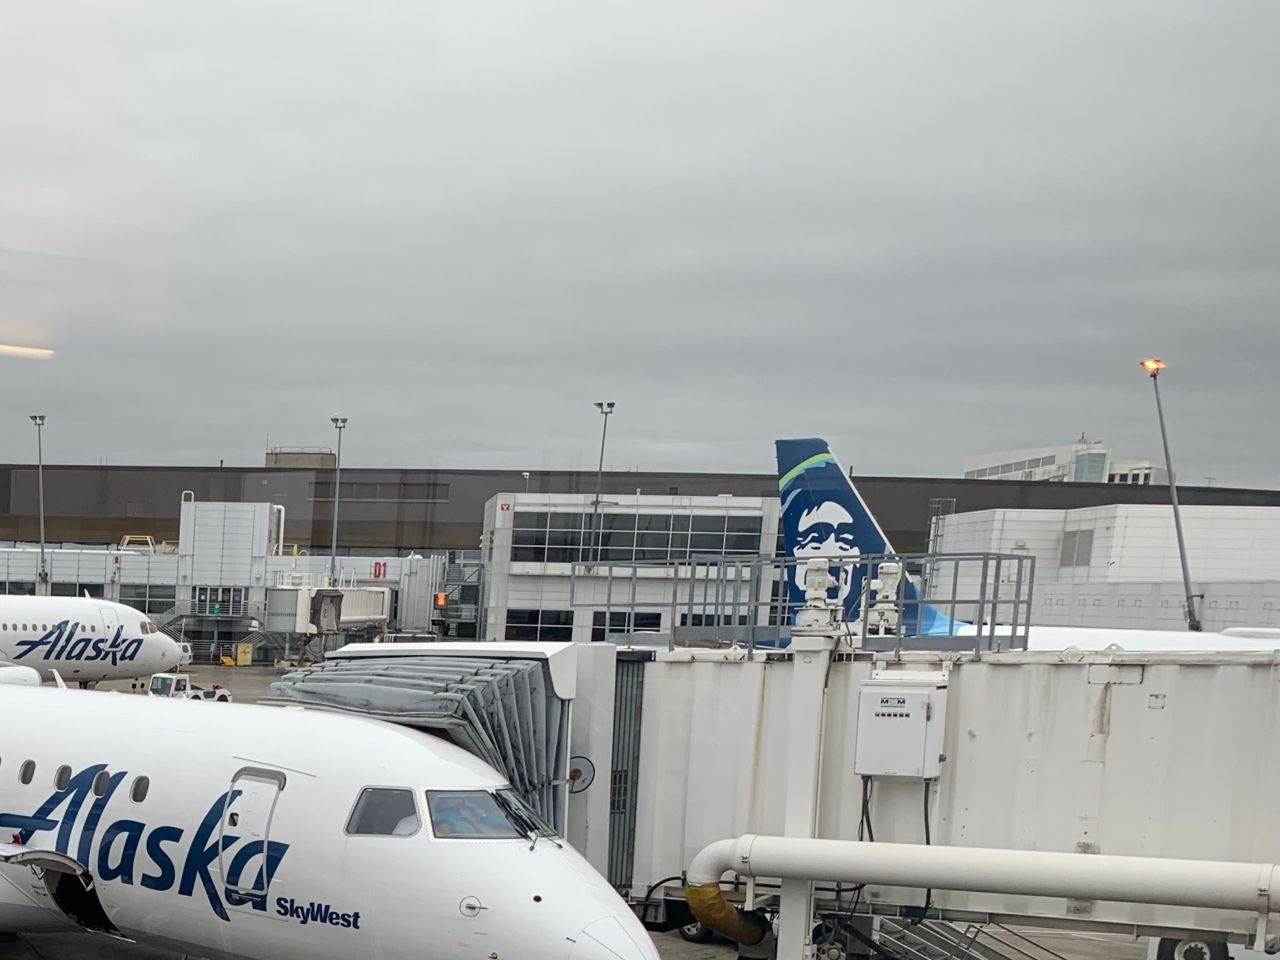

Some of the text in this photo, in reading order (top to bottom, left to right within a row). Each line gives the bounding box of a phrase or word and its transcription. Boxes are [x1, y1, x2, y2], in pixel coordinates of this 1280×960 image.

[373, 561, 387, 579] D1
[12, 619, 145, 667] Alaska
[275, 896, 361, 930] SkyWest
